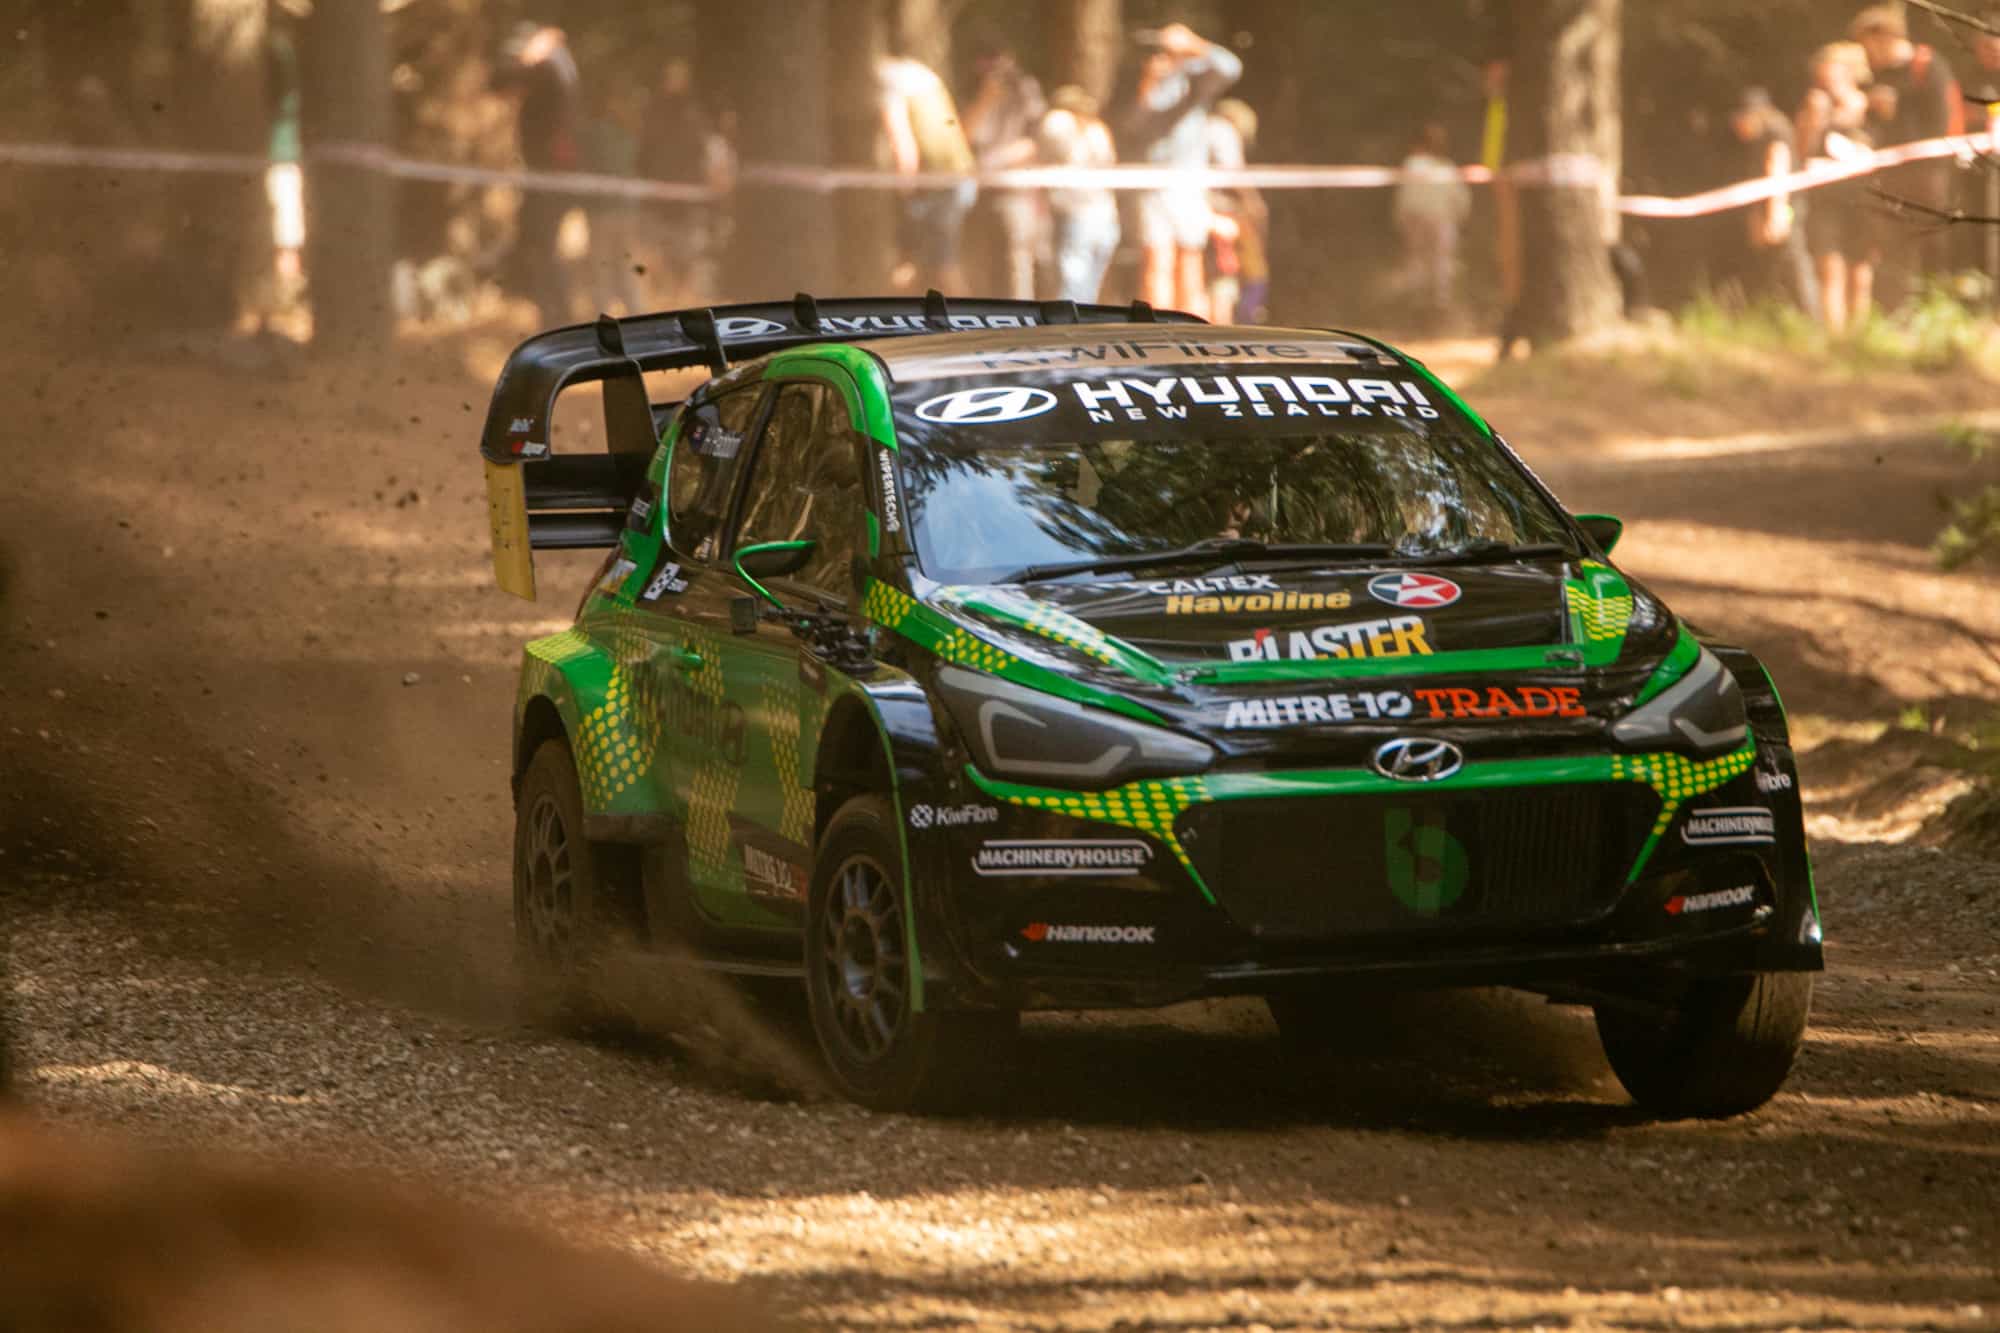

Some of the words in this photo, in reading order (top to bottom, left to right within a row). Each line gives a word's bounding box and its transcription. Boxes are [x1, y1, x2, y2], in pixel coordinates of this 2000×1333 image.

[816, 315, 1038, 332] YUNDAI
[1072, 375, 1431, 409] HYUNDAI
[1087, 405, 1188, 423] NEW
[1220, 403, 1440, 419] ZEALAND
[1148, 575, 1282, 595] CALTEX
[1165, 590, 1352, 615] Havoline
[1224, 693, 1354, 730] MITRE
[1356, 691, 1413, 720] 10
[1416, 688, 1588, 719] TRADE
[936, 804, 999, 826] KiwiFibre
[978, 848, 1147, 868] MACHINERYHOUSE
